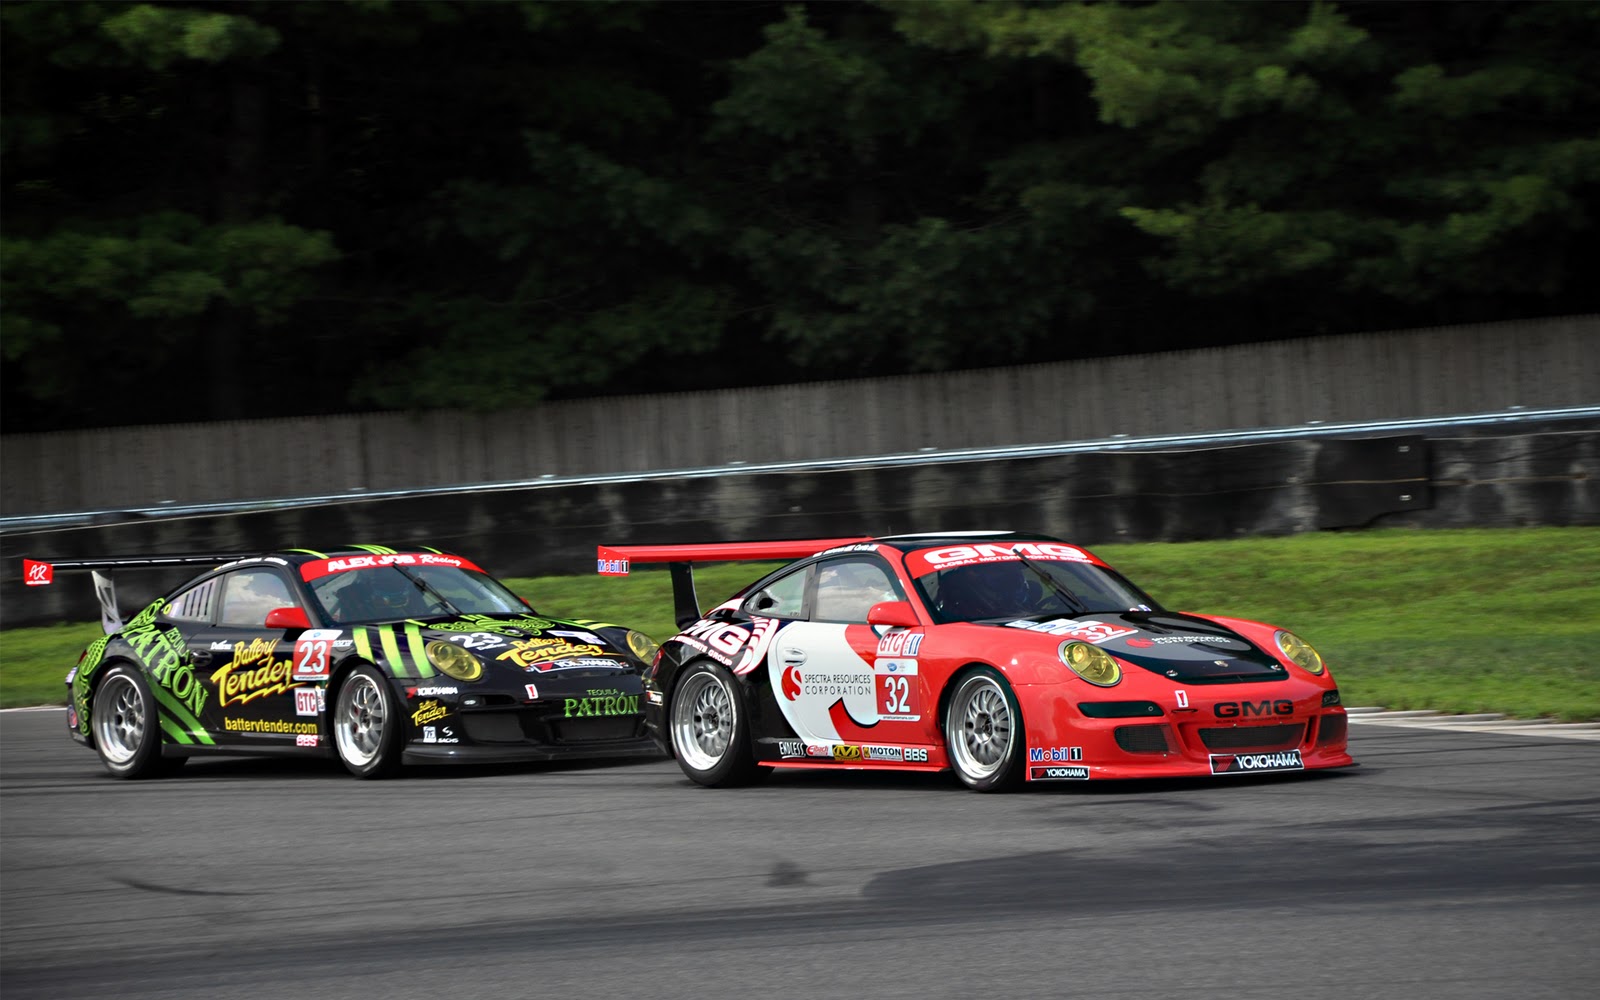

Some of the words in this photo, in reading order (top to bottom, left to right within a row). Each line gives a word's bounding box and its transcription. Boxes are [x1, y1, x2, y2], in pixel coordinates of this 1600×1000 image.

[923, 543, 1087, 564] GMG
[327, 556, 376, 572] ALEX
[378, 554, 416, 565] JOB
[419, 554, 462, 566] Racing
[597, 559, 620, 573] Mobil
[933, 559, 977, 569] GLOBAL
[450, 632, 508, 648] 23
[1071, 625, 1126, 640] 32
[165, 626, 191, 662] TEQUILA
[510, 637, 567, 650] Battery
[880, 632, 905, 653] GTC
[231, 637, 280, 669] Battery
[297, 641, 325, 673] 23
[495, 643, 605, 668] Tender
[121, 623, 209, 718] PATRÓN
[804, 673, 831, 684] SPECTRA
[833, 674, 871, 684] RESOURCES
[209, 656, 293, 707] Tender
[804, 685, 871, 695] CORPORATION
[586, 688, 619, 696] TEQUILA
[884, 676, 911, 713] 32
[296, 691, 316, 713] GTC
[563, 692, 639, 718] PATRÓN
[1213, 699, 1294, 718] GMG
[411, 706, 447, 727] Tender
[225, 717, 318, 734] batterytender.com
[870, 747, 902, 756] MOTON
[904, 748, 928, 762] BBS
[1030, 747, 1069, 762] Mobil
[1070, 747, 1082, 761] 1
[1236, 752, 1301, 769] YOKOHAMA
[1046, 768, 1087, 777] YOKOHAMA
